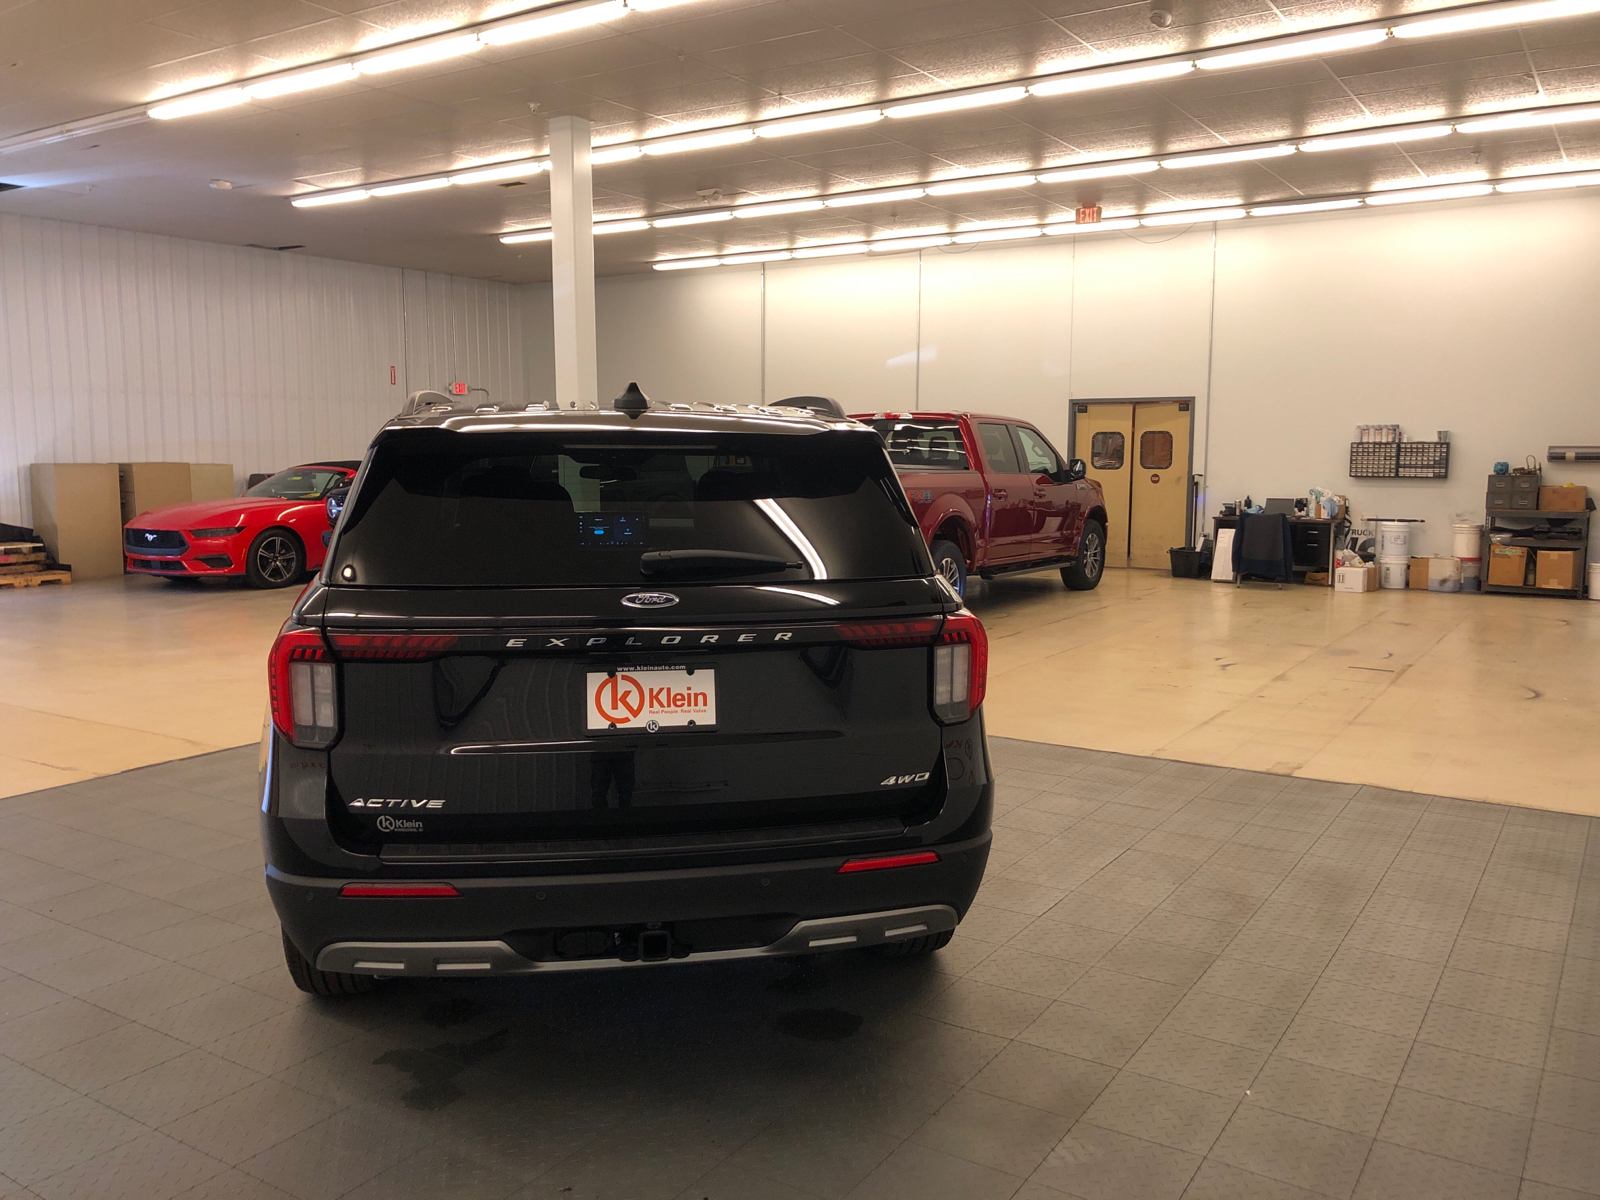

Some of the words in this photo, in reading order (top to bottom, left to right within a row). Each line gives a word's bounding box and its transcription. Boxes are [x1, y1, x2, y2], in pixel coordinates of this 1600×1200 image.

[1079, 208, 1098, 223] EXIT
[635, 594, 667, 604] Ford
[505, 632, 793, 647] EXPLORER
[648, 687, 708, 709] Klein
[880, 771, 930, 786] 4WD
[348, 797, 446, 808] ACTIVE
[395, 819, 423, 828] Klein
